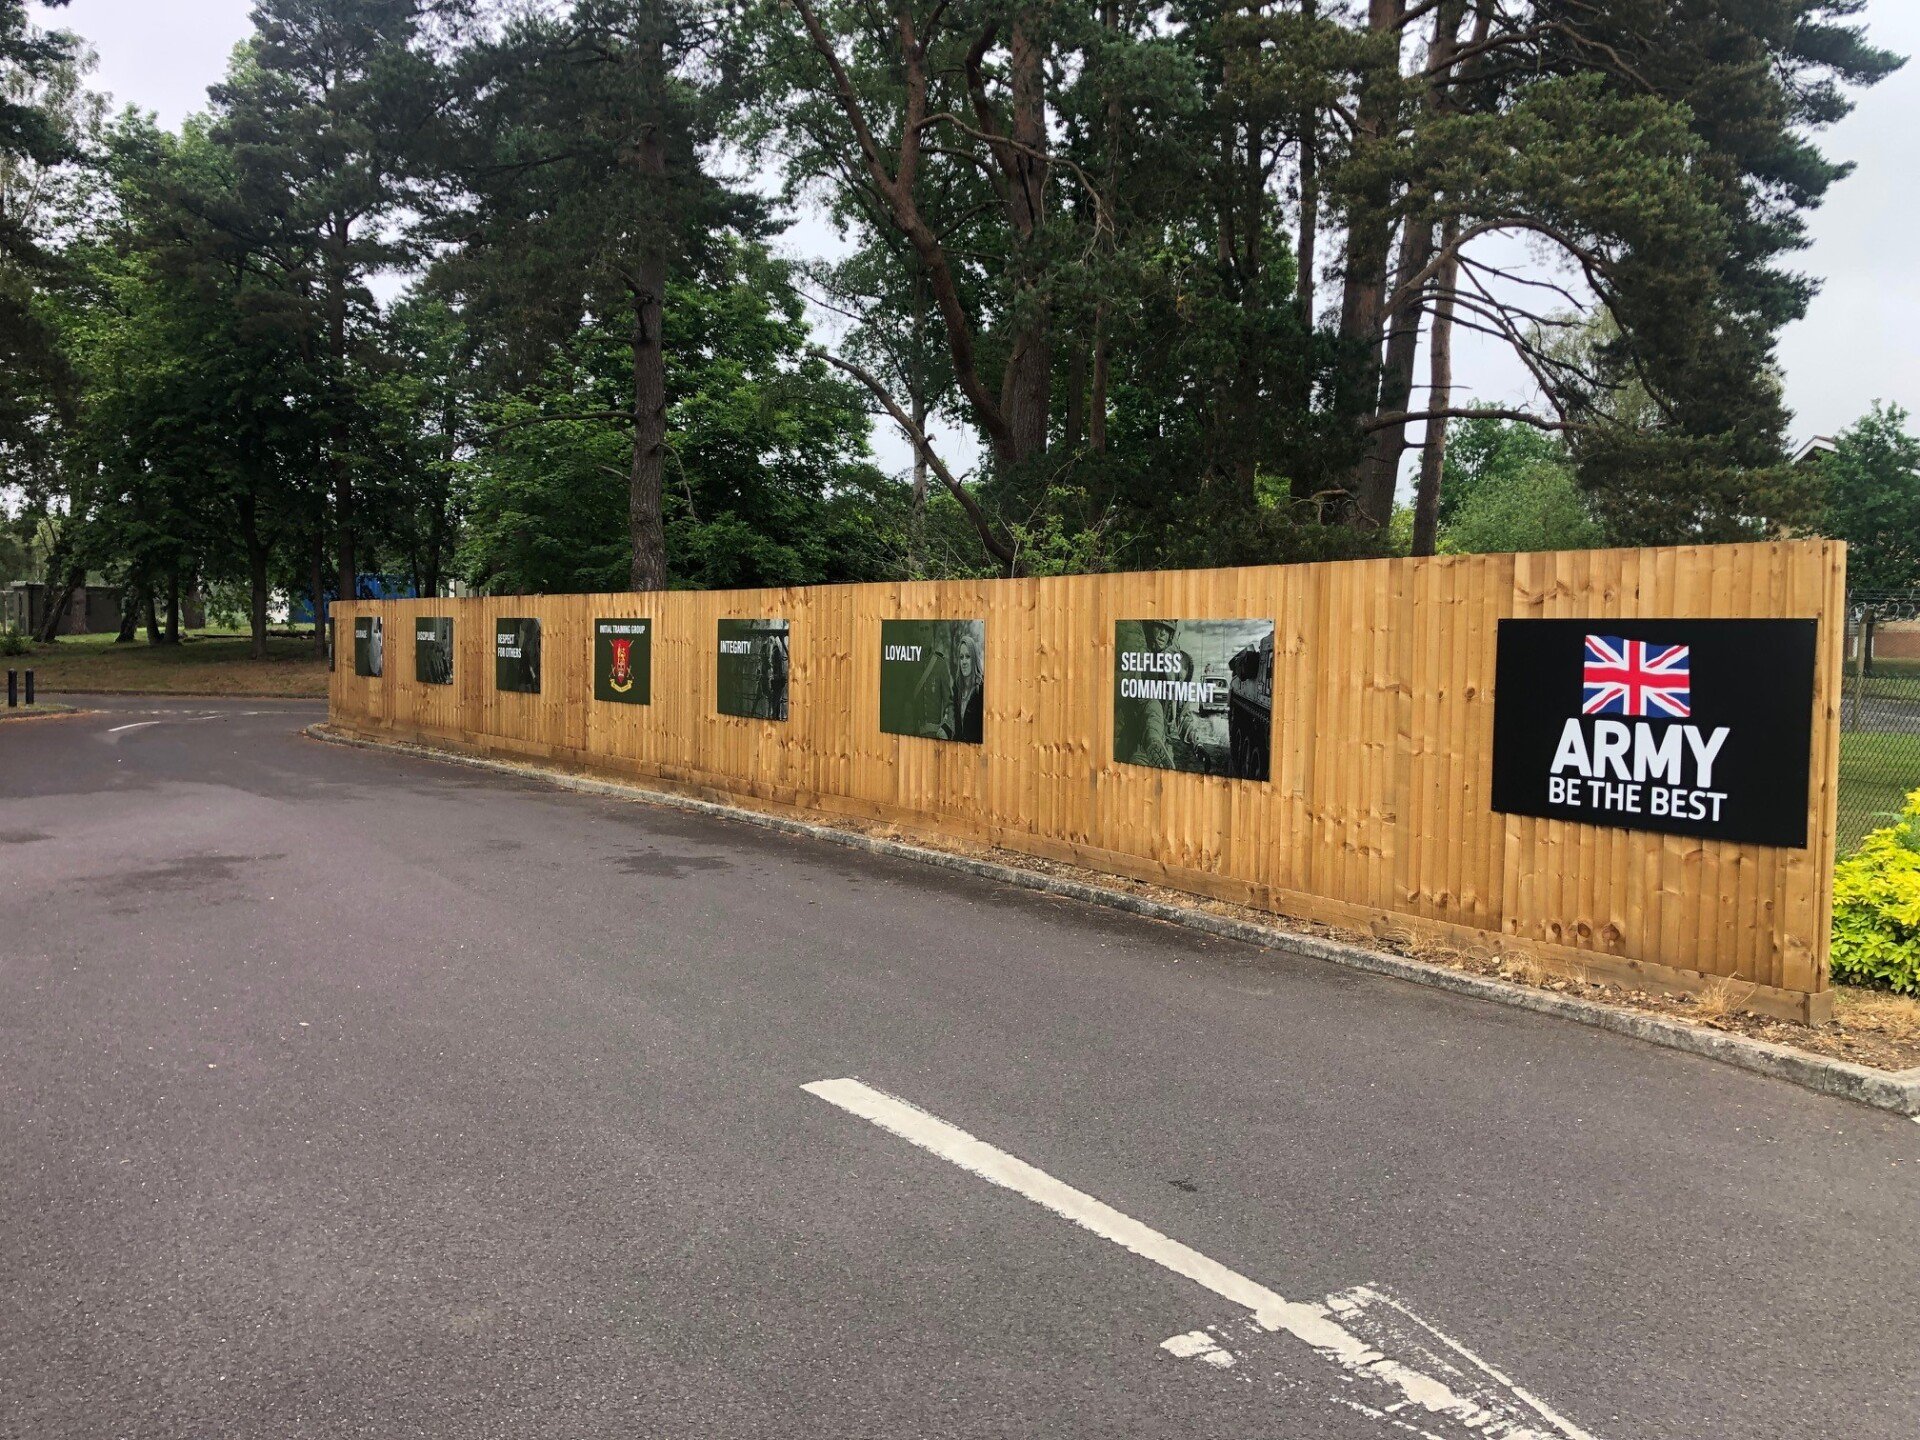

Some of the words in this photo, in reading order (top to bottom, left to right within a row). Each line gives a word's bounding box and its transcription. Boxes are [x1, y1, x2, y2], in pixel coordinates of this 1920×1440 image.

[612, 625, 631, 634] TRAINING
[631, 625, 646, 634] GROUP
[497, 633, 515, 644] RESPECT
[720, 640, 751, 654] INTEGRITY
[497, 647, 505, 657] FOR
[506, 648, 522, 658] OTHERS
[885, 645, 922, 662] LOYALTY
[1121, 652, 1182, 673] SELFLESS
[1121, 678, 1216, 703] COMMITMENT
[1550, 717, 1731, 788] ARMY
[1549, 776, 1582, 806] BE
[1587, 780, 1642, 813] THE
[1650, 786, 1728, 822] BEST
